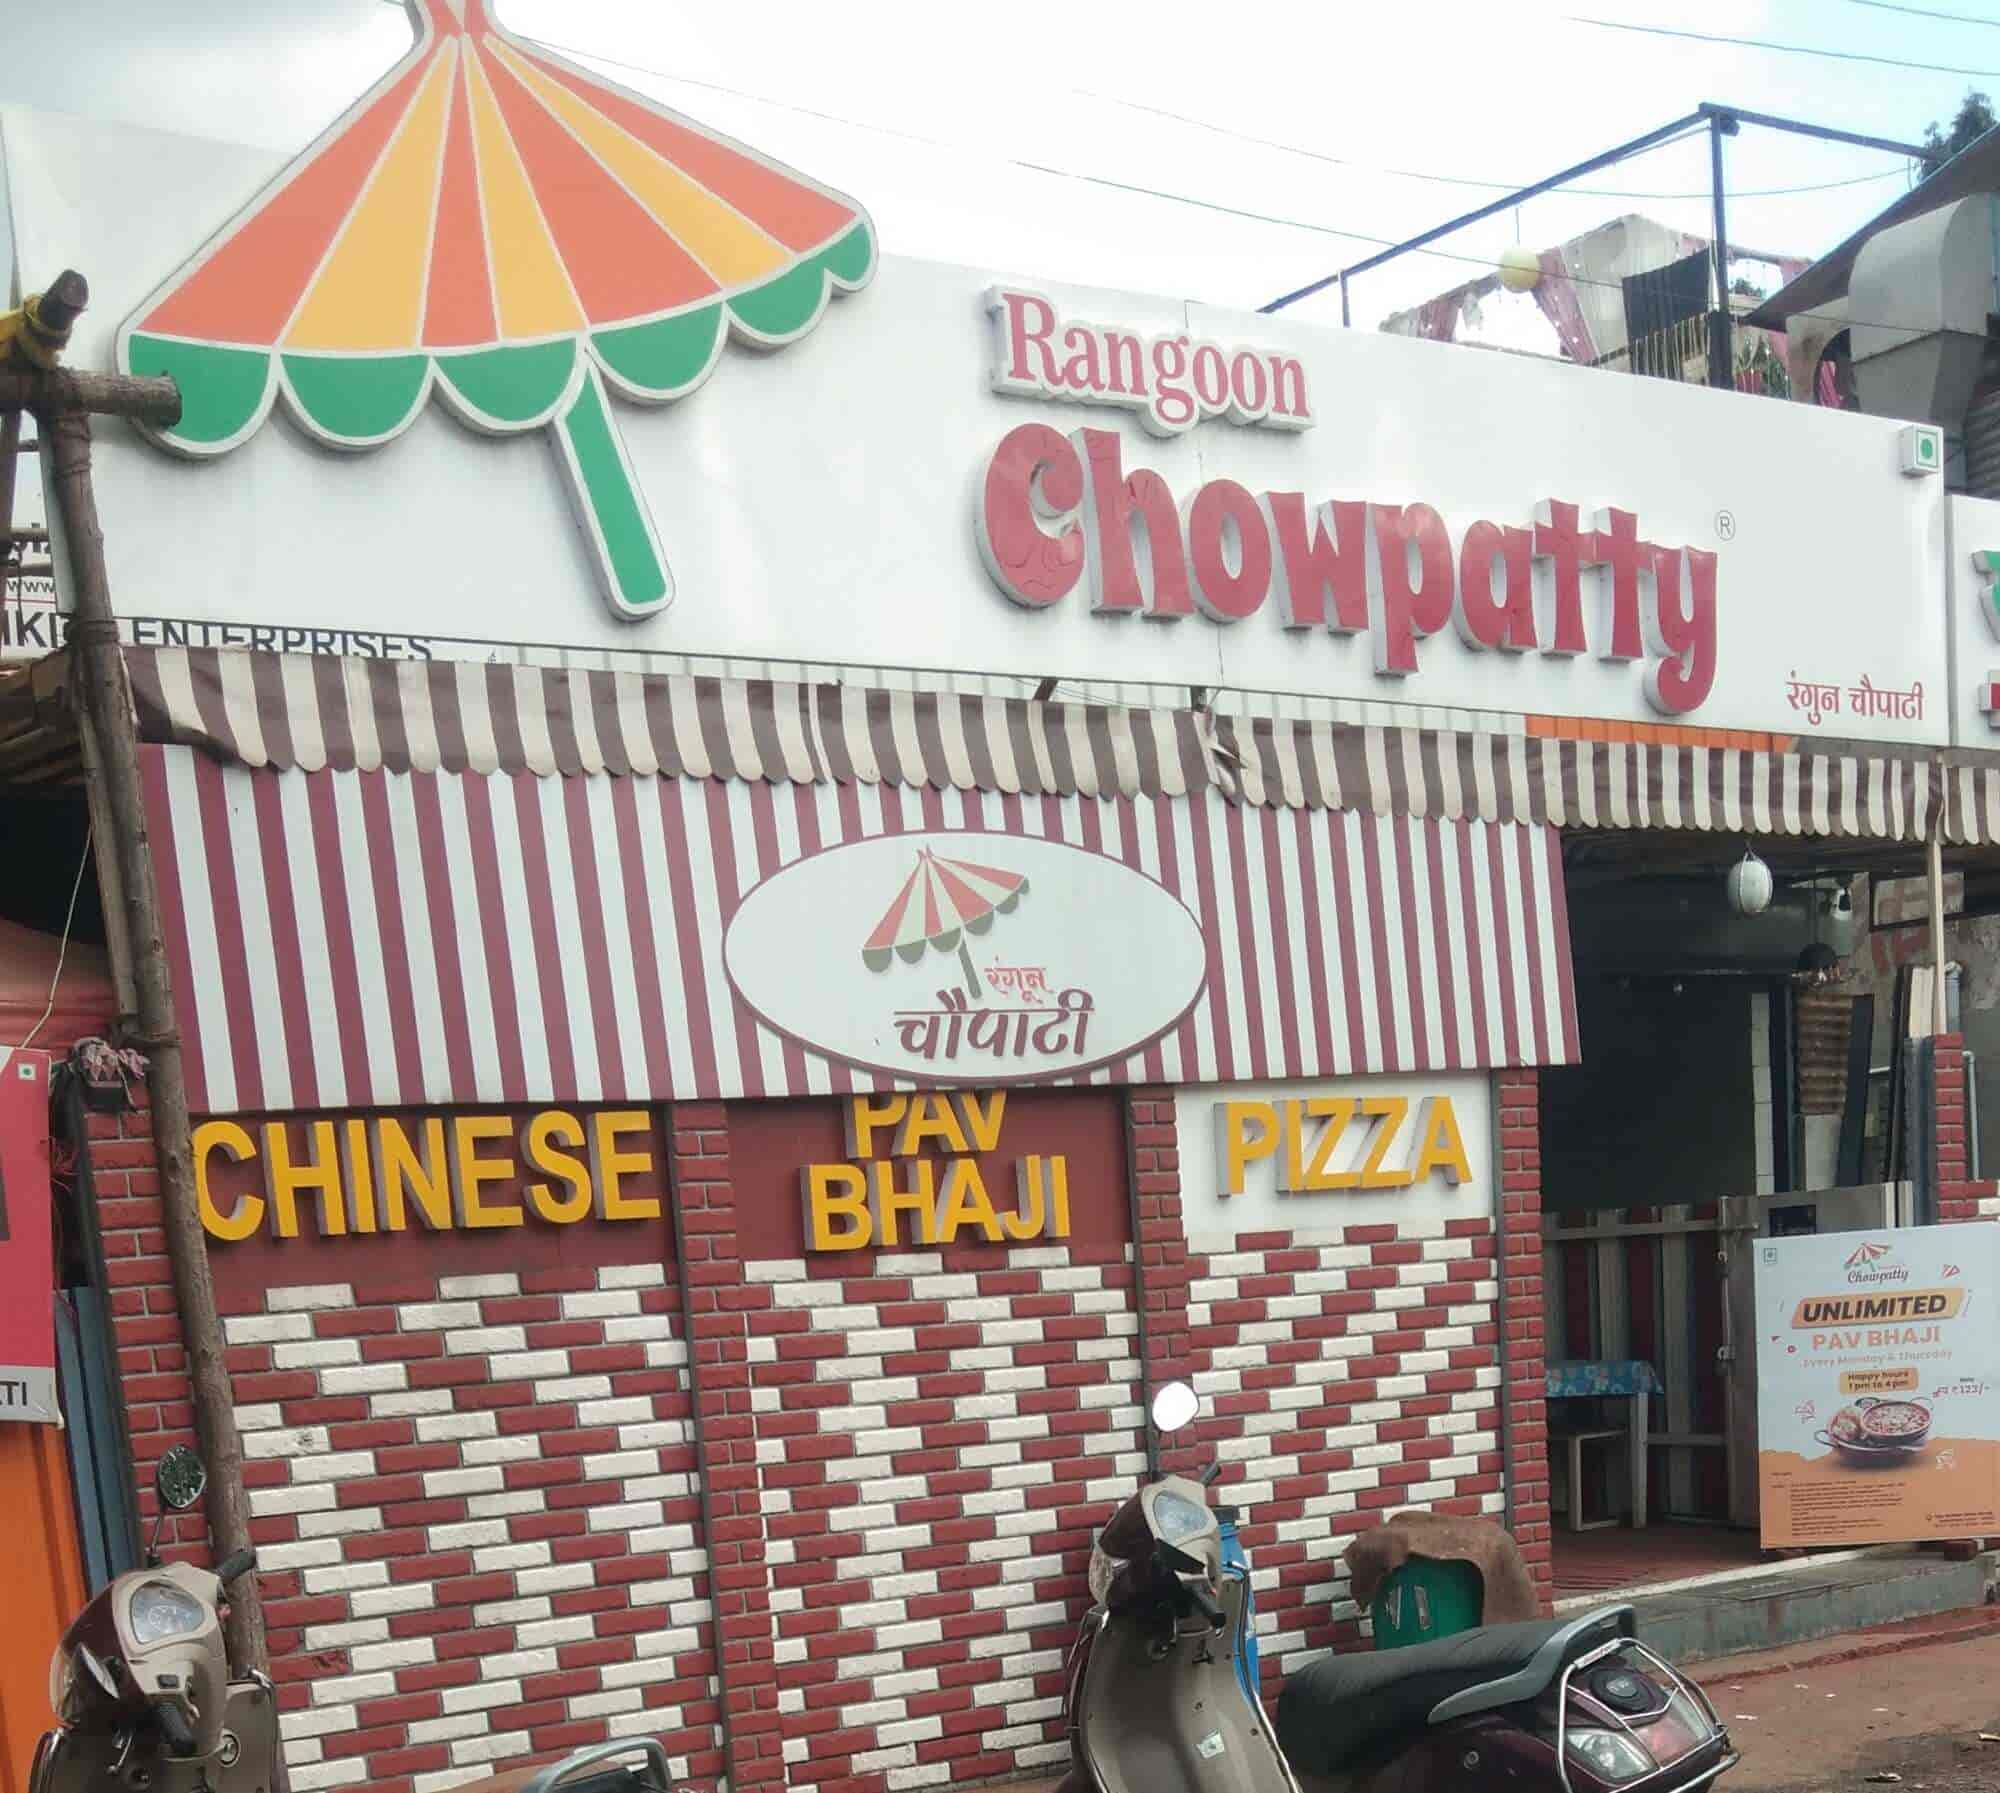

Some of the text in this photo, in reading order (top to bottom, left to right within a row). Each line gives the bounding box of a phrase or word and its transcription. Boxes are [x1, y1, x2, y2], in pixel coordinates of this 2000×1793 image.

[1001, 291, 1312, 425] Rangoon
[980, 422, 1719, 714] Chowpatty
[893, 987, 1096, 1060] चौपाटी
[850, 1090, 1008, 1159] PAV
[1221, 1096, 1473, 1196] PIZZA
[191, 1109, 661, 1241] CHINESE
[805, 1154, 1071, 1251] BHAJI
[1803, 1294, 1947, 1322] UNLIMITED
[1812, 1326, 1941, 1350] PAV BHAJI
